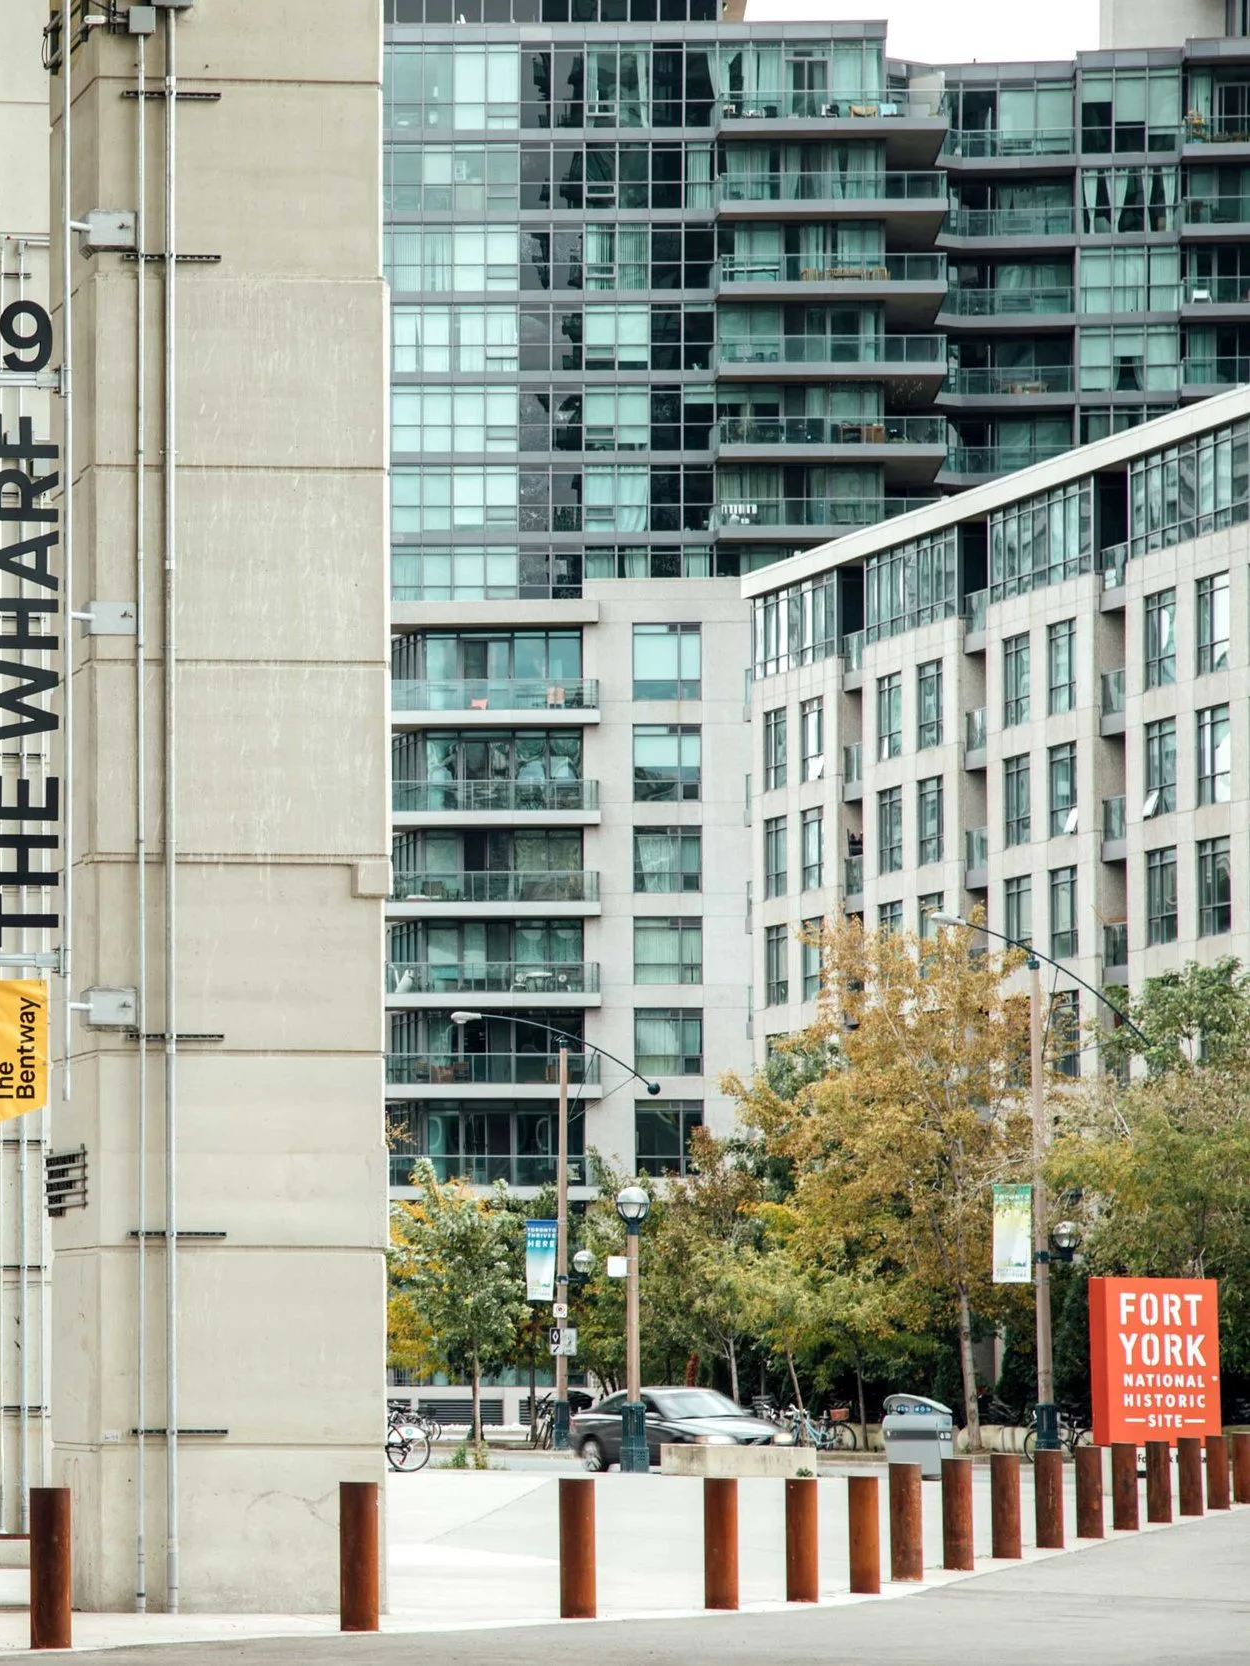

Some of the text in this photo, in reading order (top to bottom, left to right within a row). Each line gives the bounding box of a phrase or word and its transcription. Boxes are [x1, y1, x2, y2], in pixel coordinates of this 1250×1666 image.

[16, 997, 41, 1099] Bentway
[527, 1240, 556, 1248] HERE
[1119, 1293, 1203, 1326] FORT
[1119, 1333, 1207, 1367] YORK
[1123, 1374, 1205, 1387] NATIONAL
[1124, 1393, 1206, 1408] HISTORIC
[1147, 1414, 1183, 1428] SITE
